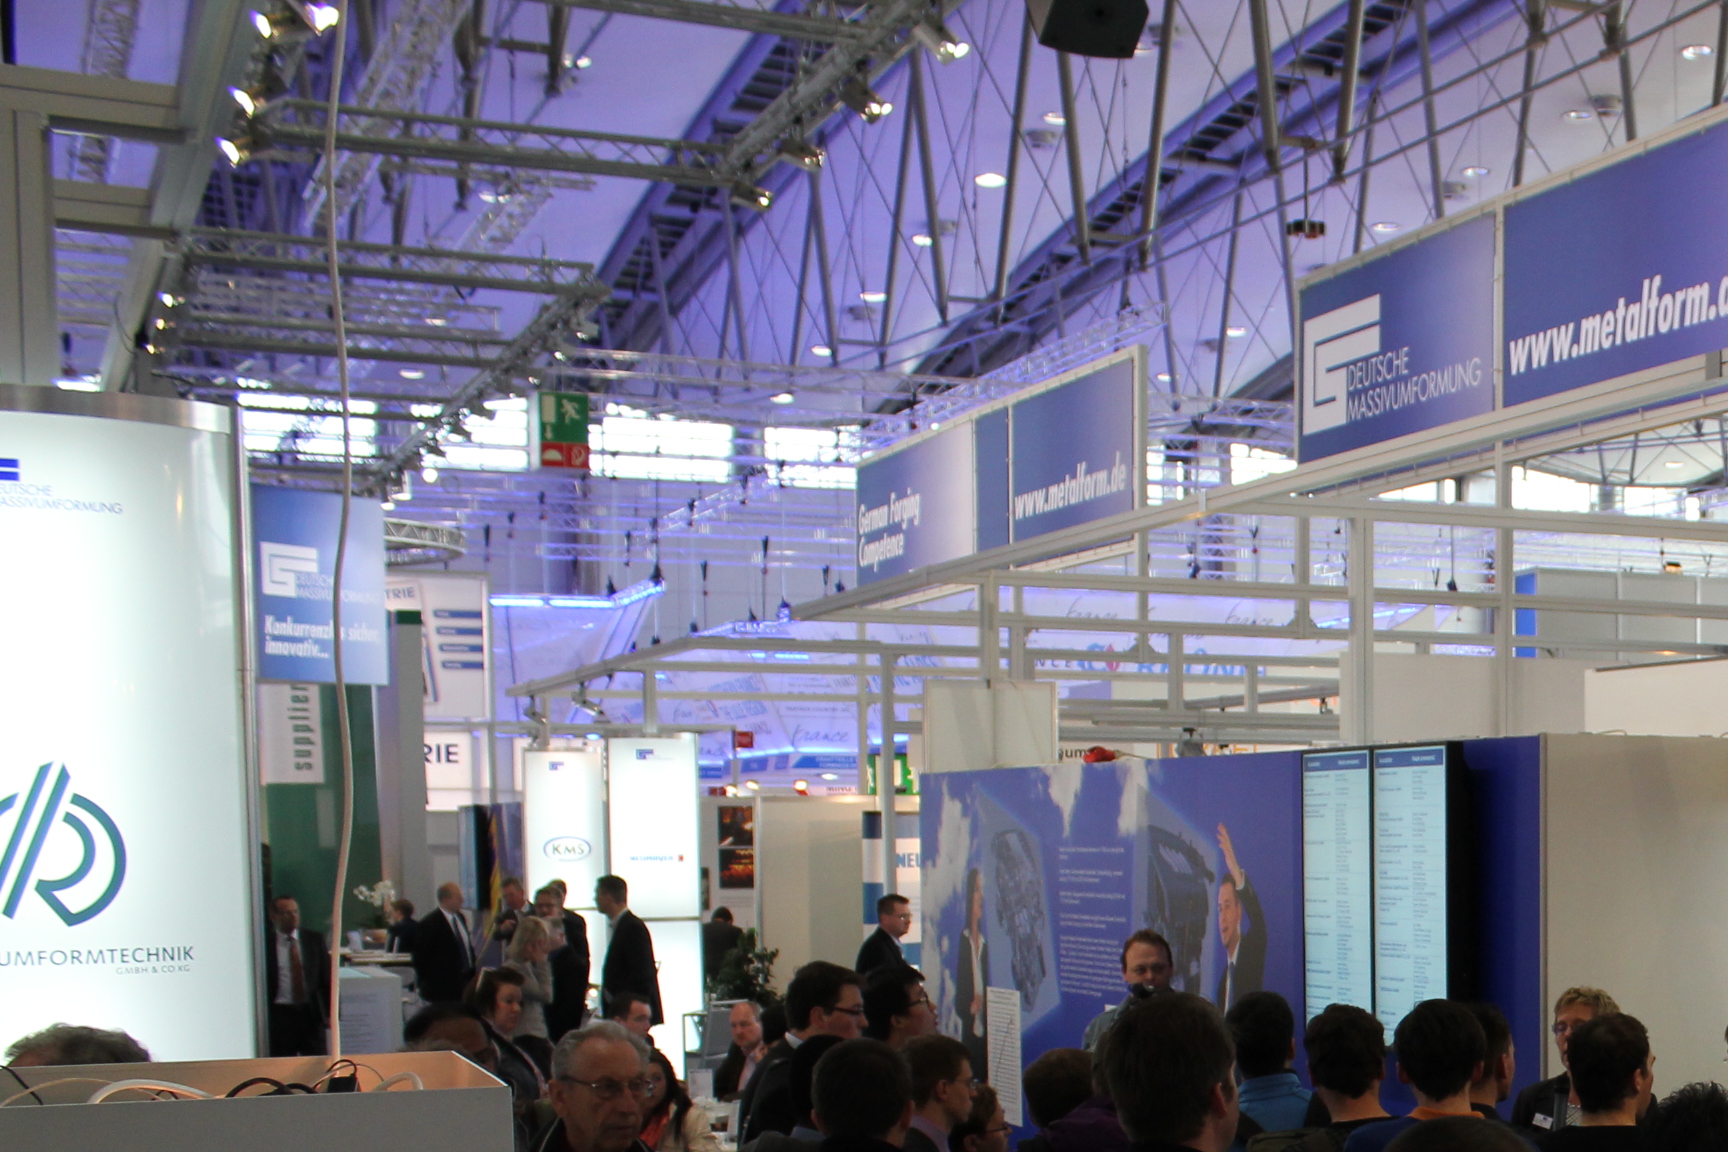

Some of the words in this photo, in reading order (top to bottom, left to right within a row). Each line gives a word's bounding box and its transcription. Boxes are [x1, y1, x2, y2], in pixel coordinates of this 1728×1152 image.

[1347, 345, 1409, 391] DEUTSCHE
[1347, 356, 1481, 421] MASSIVUMFORMUNG
[1014, 452, 1127, 520] www.metalform.de
[858, 503, 888, 536] German
[889, 487, 921, 530] Forging
[858, 532, 904, 573] Competence
[264, 614, 344, 642] Konkurrenzls
